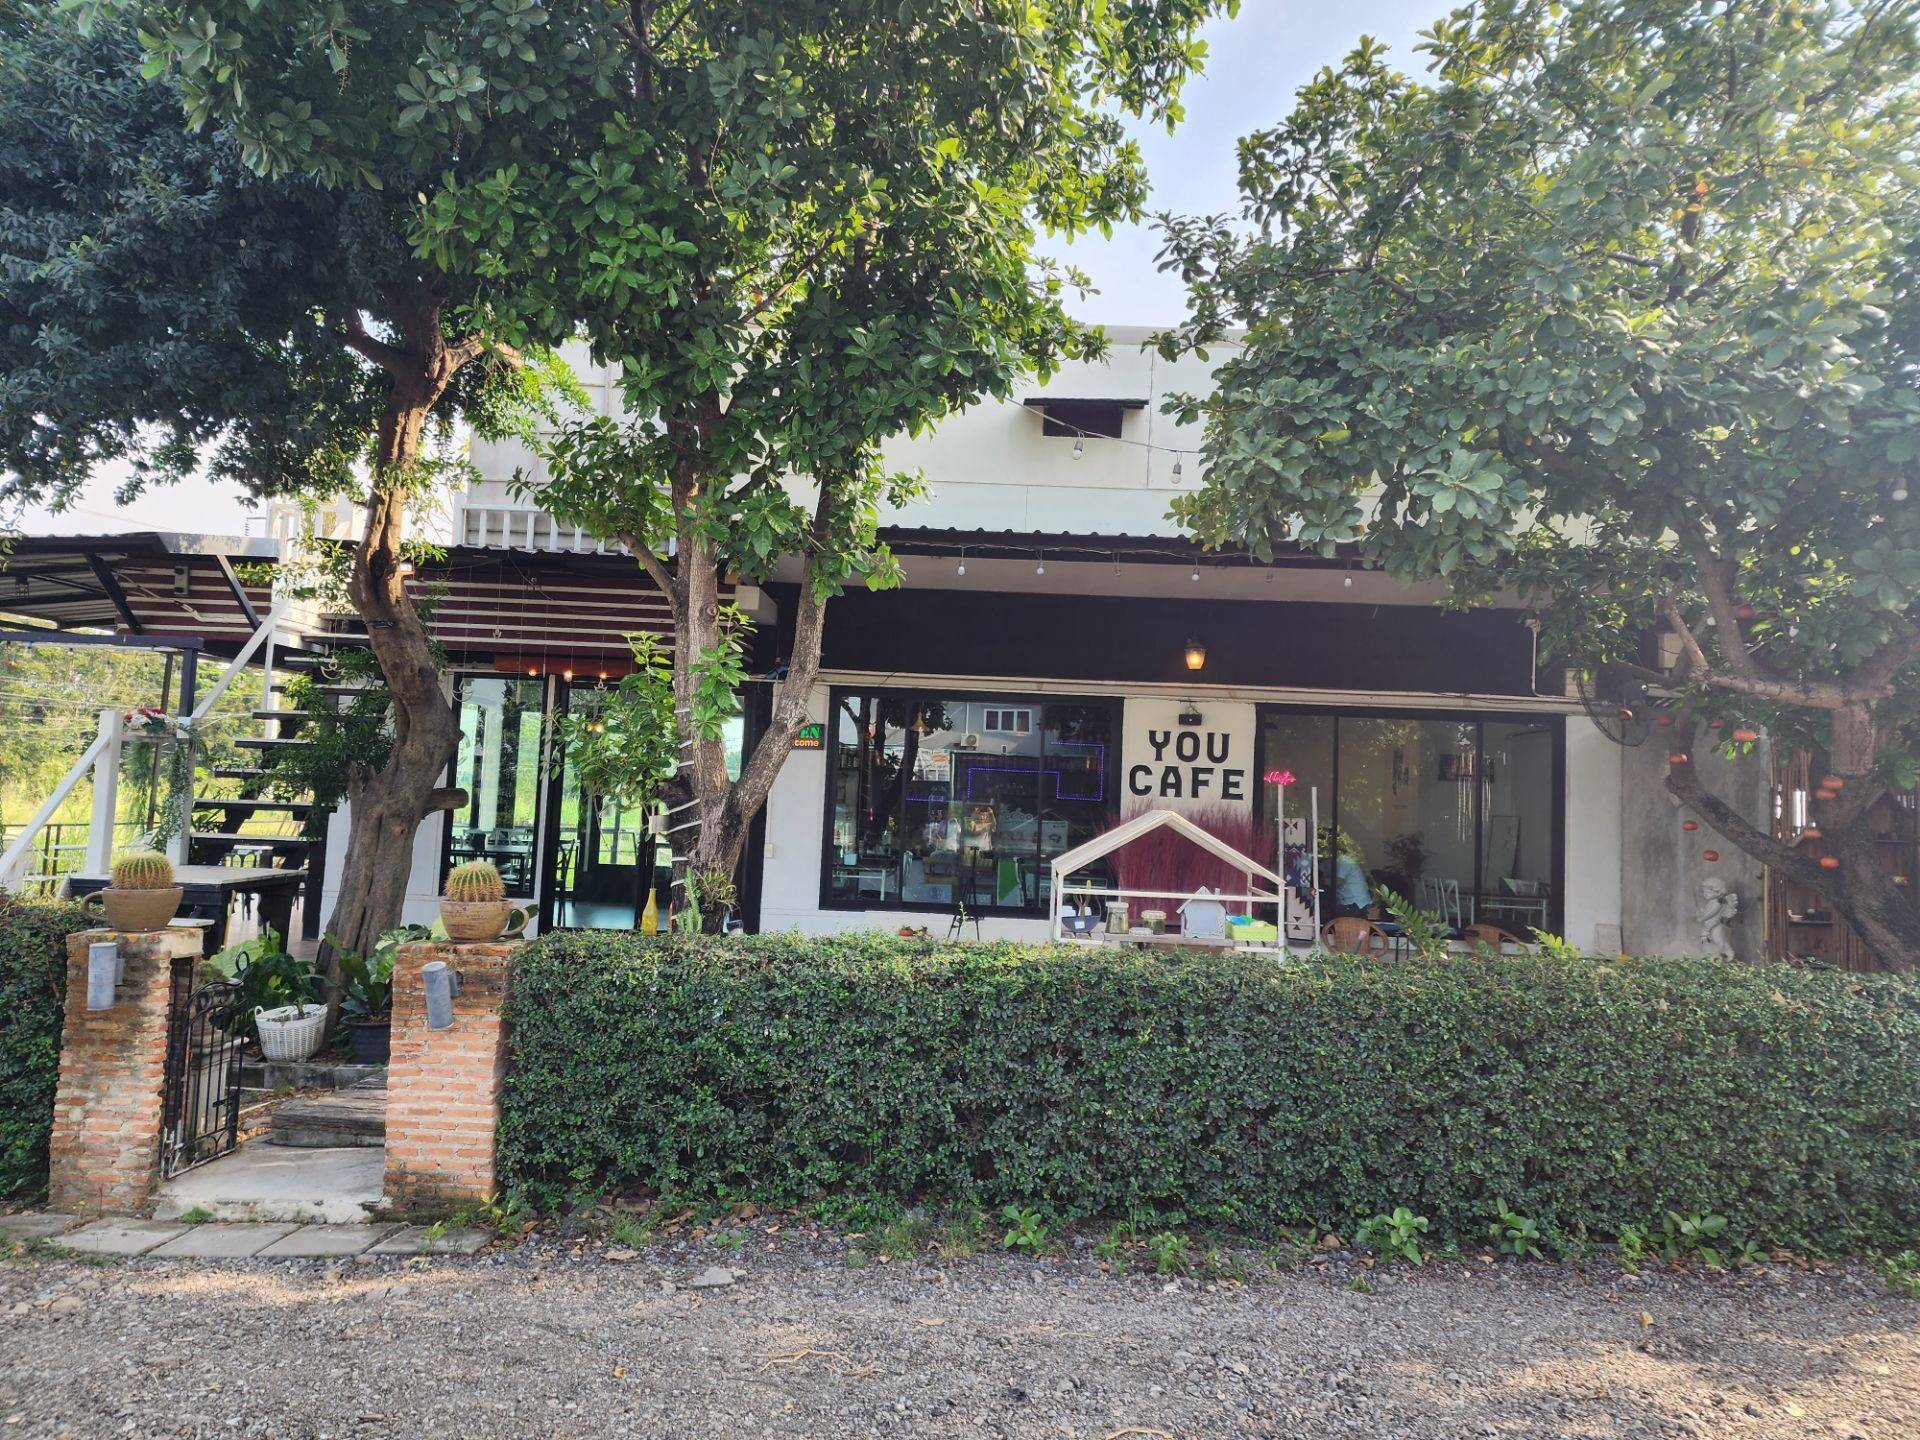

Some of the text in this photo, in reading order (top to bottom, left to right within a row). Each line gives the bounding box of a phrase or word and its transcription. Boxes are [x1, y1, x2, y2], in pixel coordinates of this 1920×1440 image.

[794, 739, 820, 747] come
[800, 726, 820, 739] EN
[1148, 730, 1231, 764] YOU
[1128, 764, 1245, 801] CAFE
